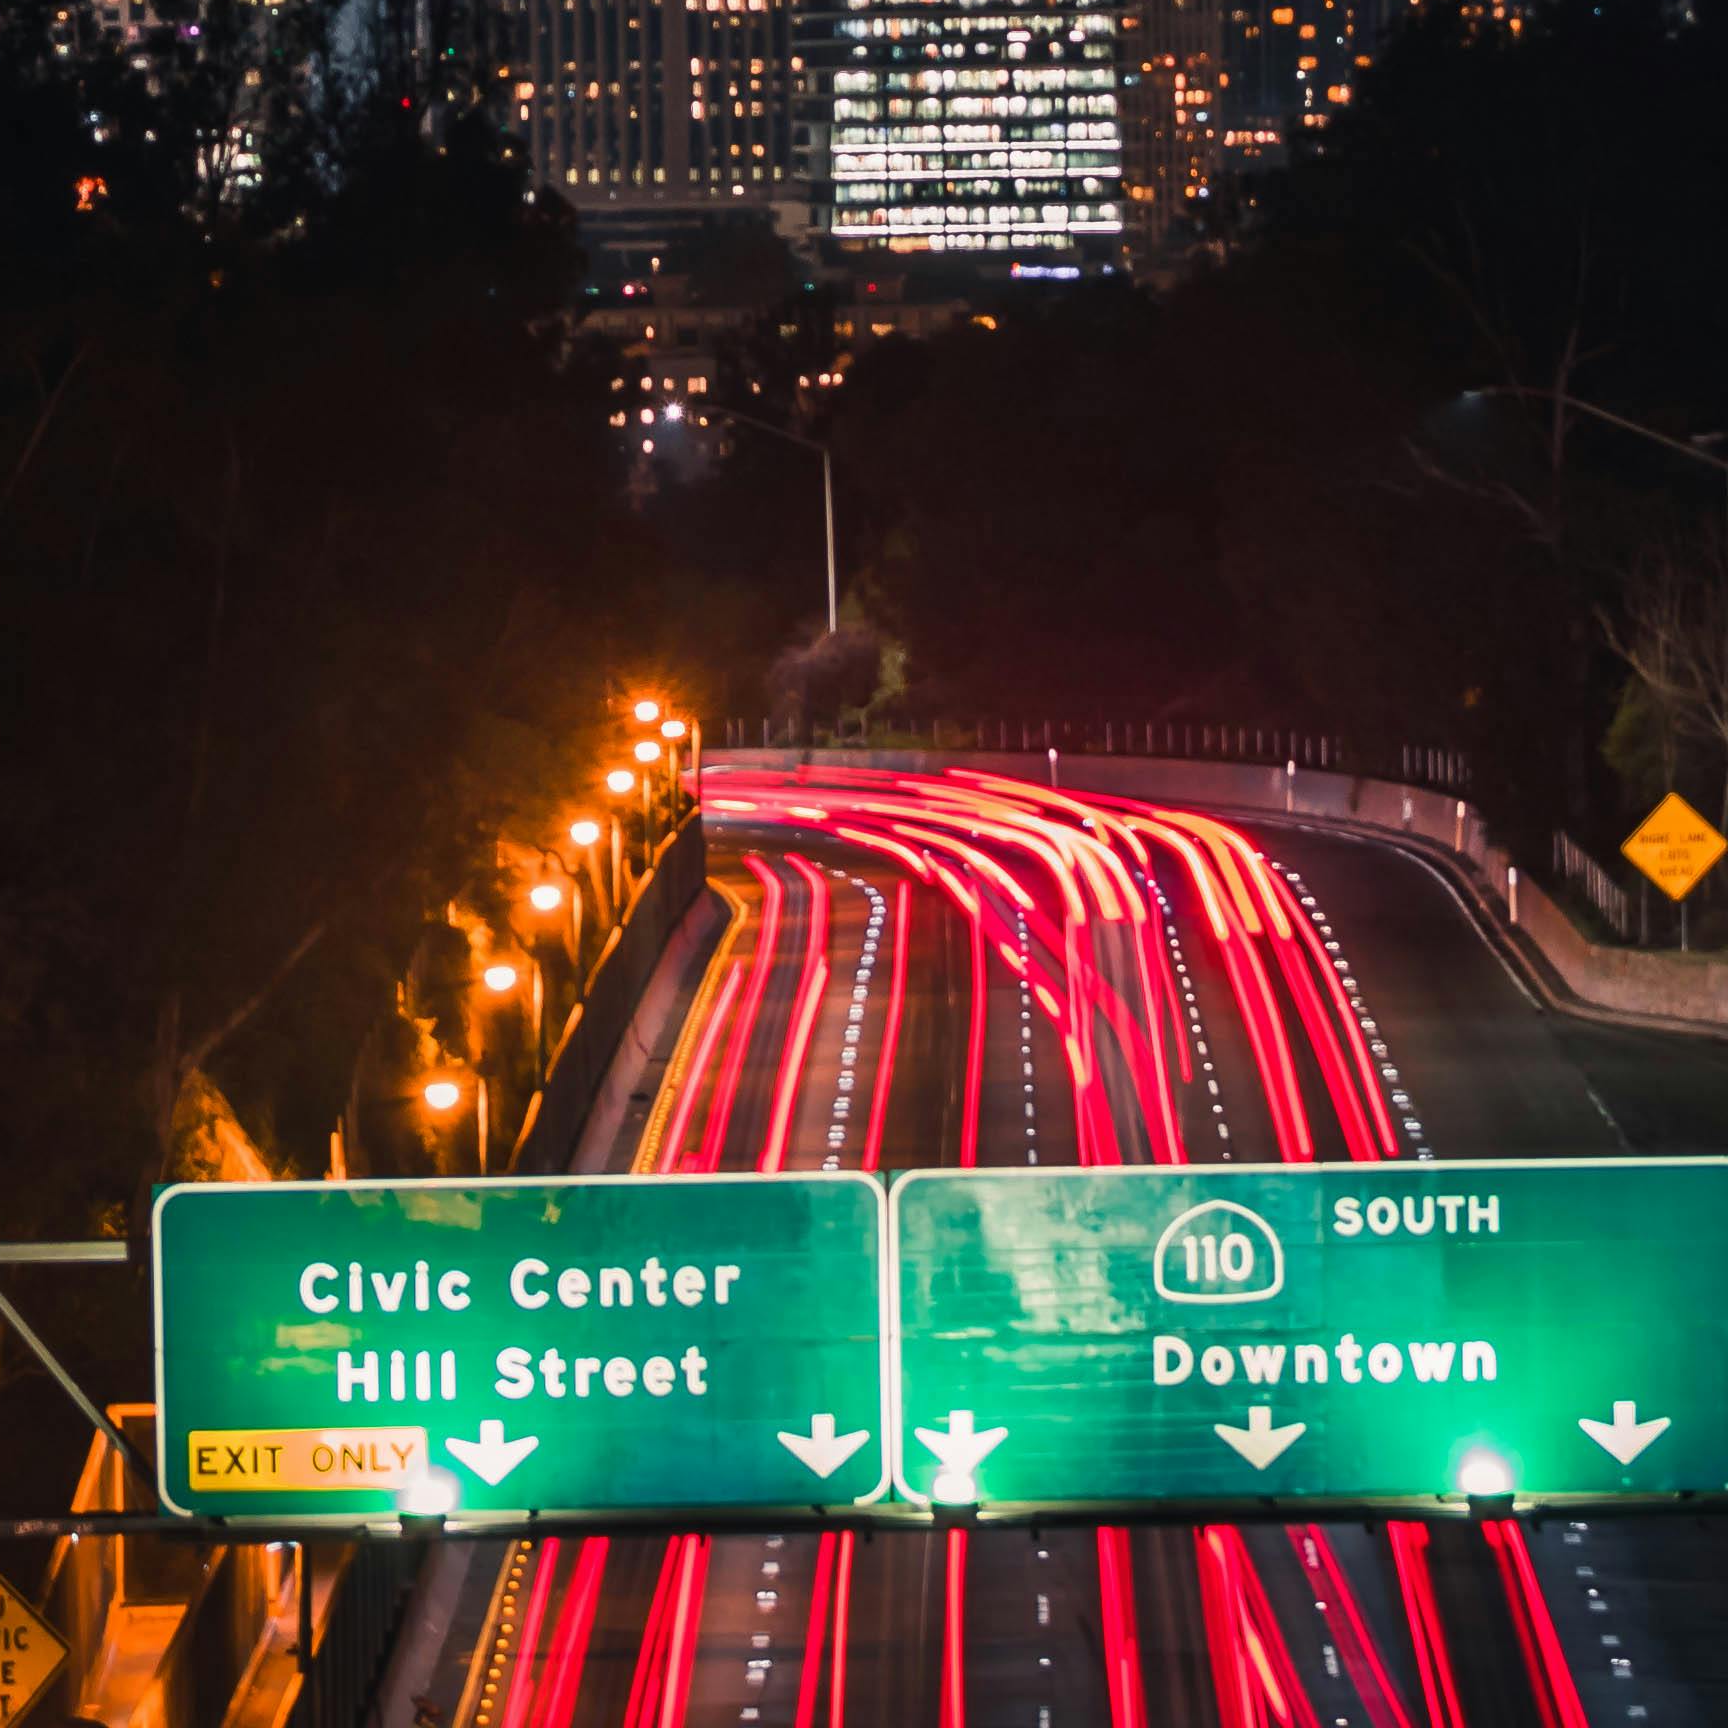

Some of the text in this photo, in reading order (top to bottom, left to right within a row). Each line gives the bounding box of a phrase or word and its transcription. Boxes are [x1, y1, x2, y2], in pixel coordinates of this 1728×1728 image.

[1333, 1195, 1500, 1237] SOUTH
[1183, 1233, 1255, 1281] 110
[299, 1257, 741, 1314] Civic Center
[335, 1346, 708, 1403] Hill Street
[1152, 1333, 1497, 1386] Downtown
[196, 1442, 416, 1476] EXIT ONLY
